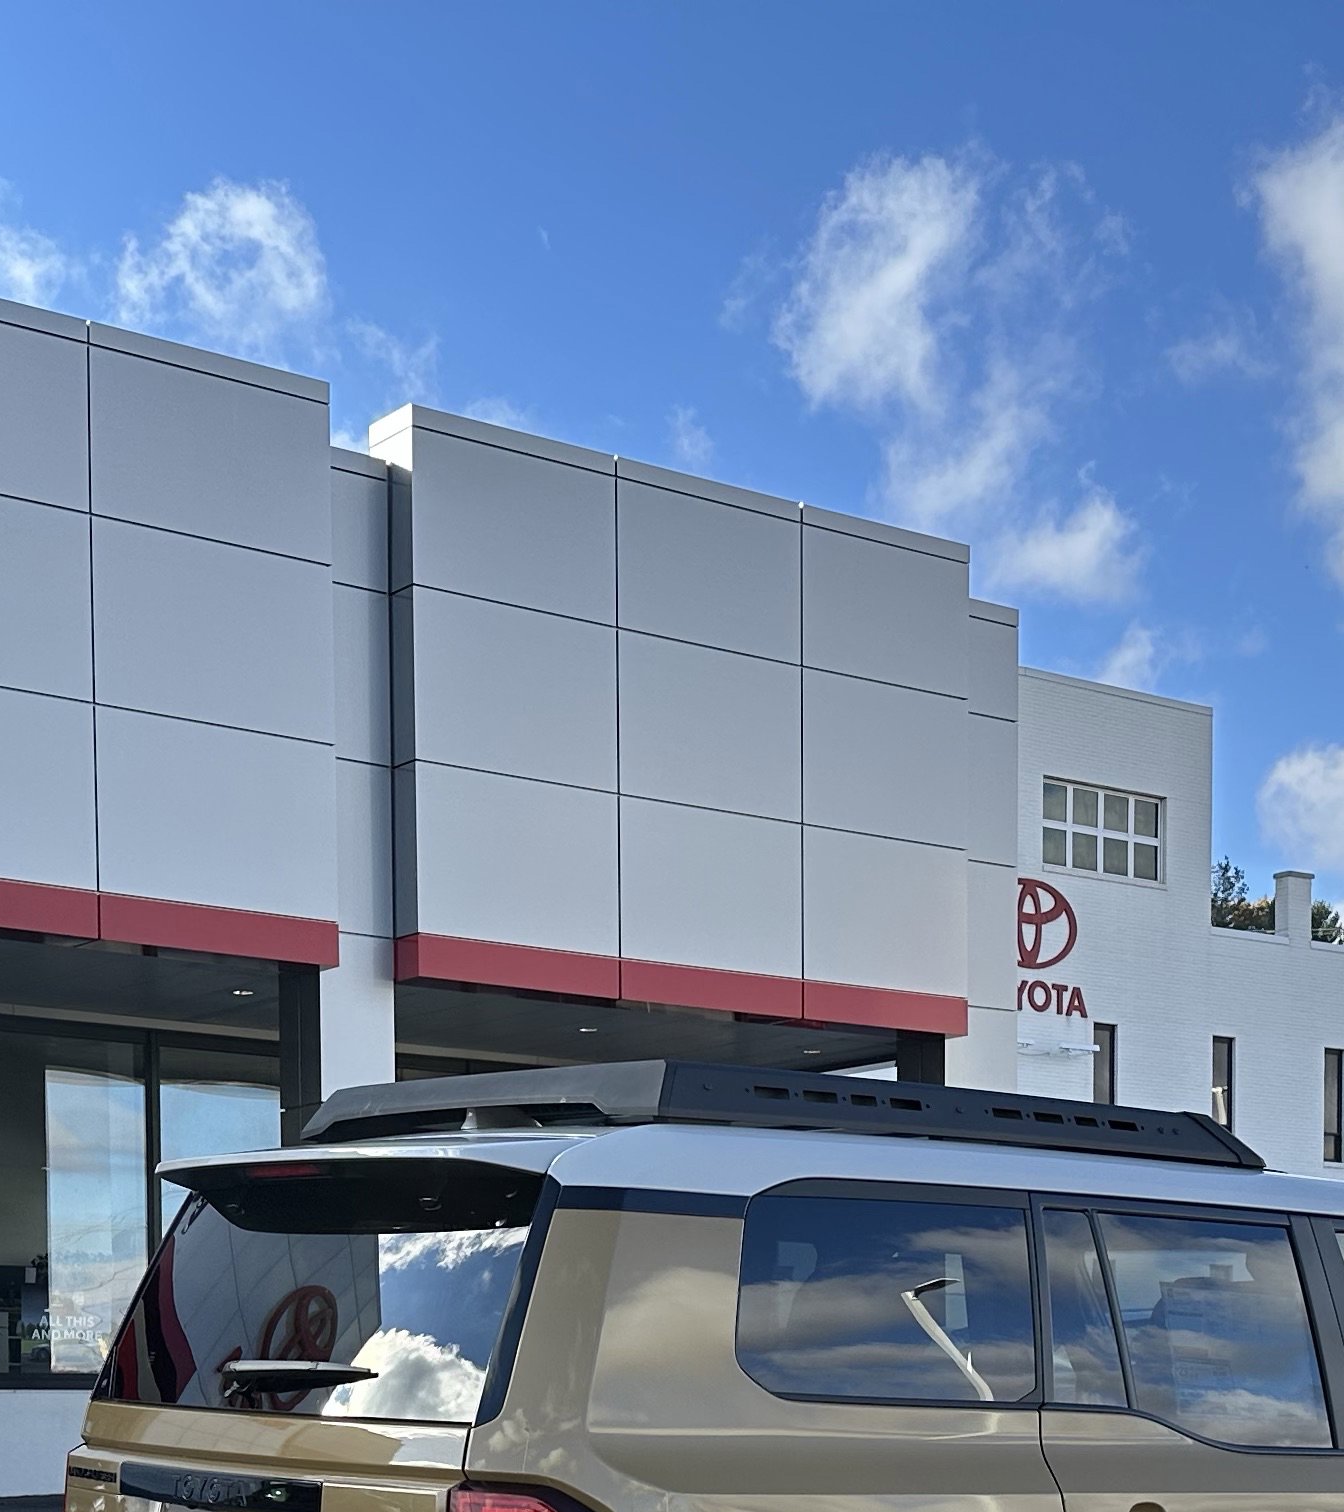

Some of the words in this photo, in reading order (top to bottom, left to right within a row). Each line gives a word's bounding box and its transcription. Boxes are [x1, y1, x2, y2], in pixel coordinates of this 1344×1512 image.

[39, 1315, 63, 1328] ALL
[65, 1315, 95, 1328] THIS
[31, 1328, 61, 1341] AND
[63, 1329, 103, 1341] MORE
[171, 1473, 249, 1508] TOYOTA
